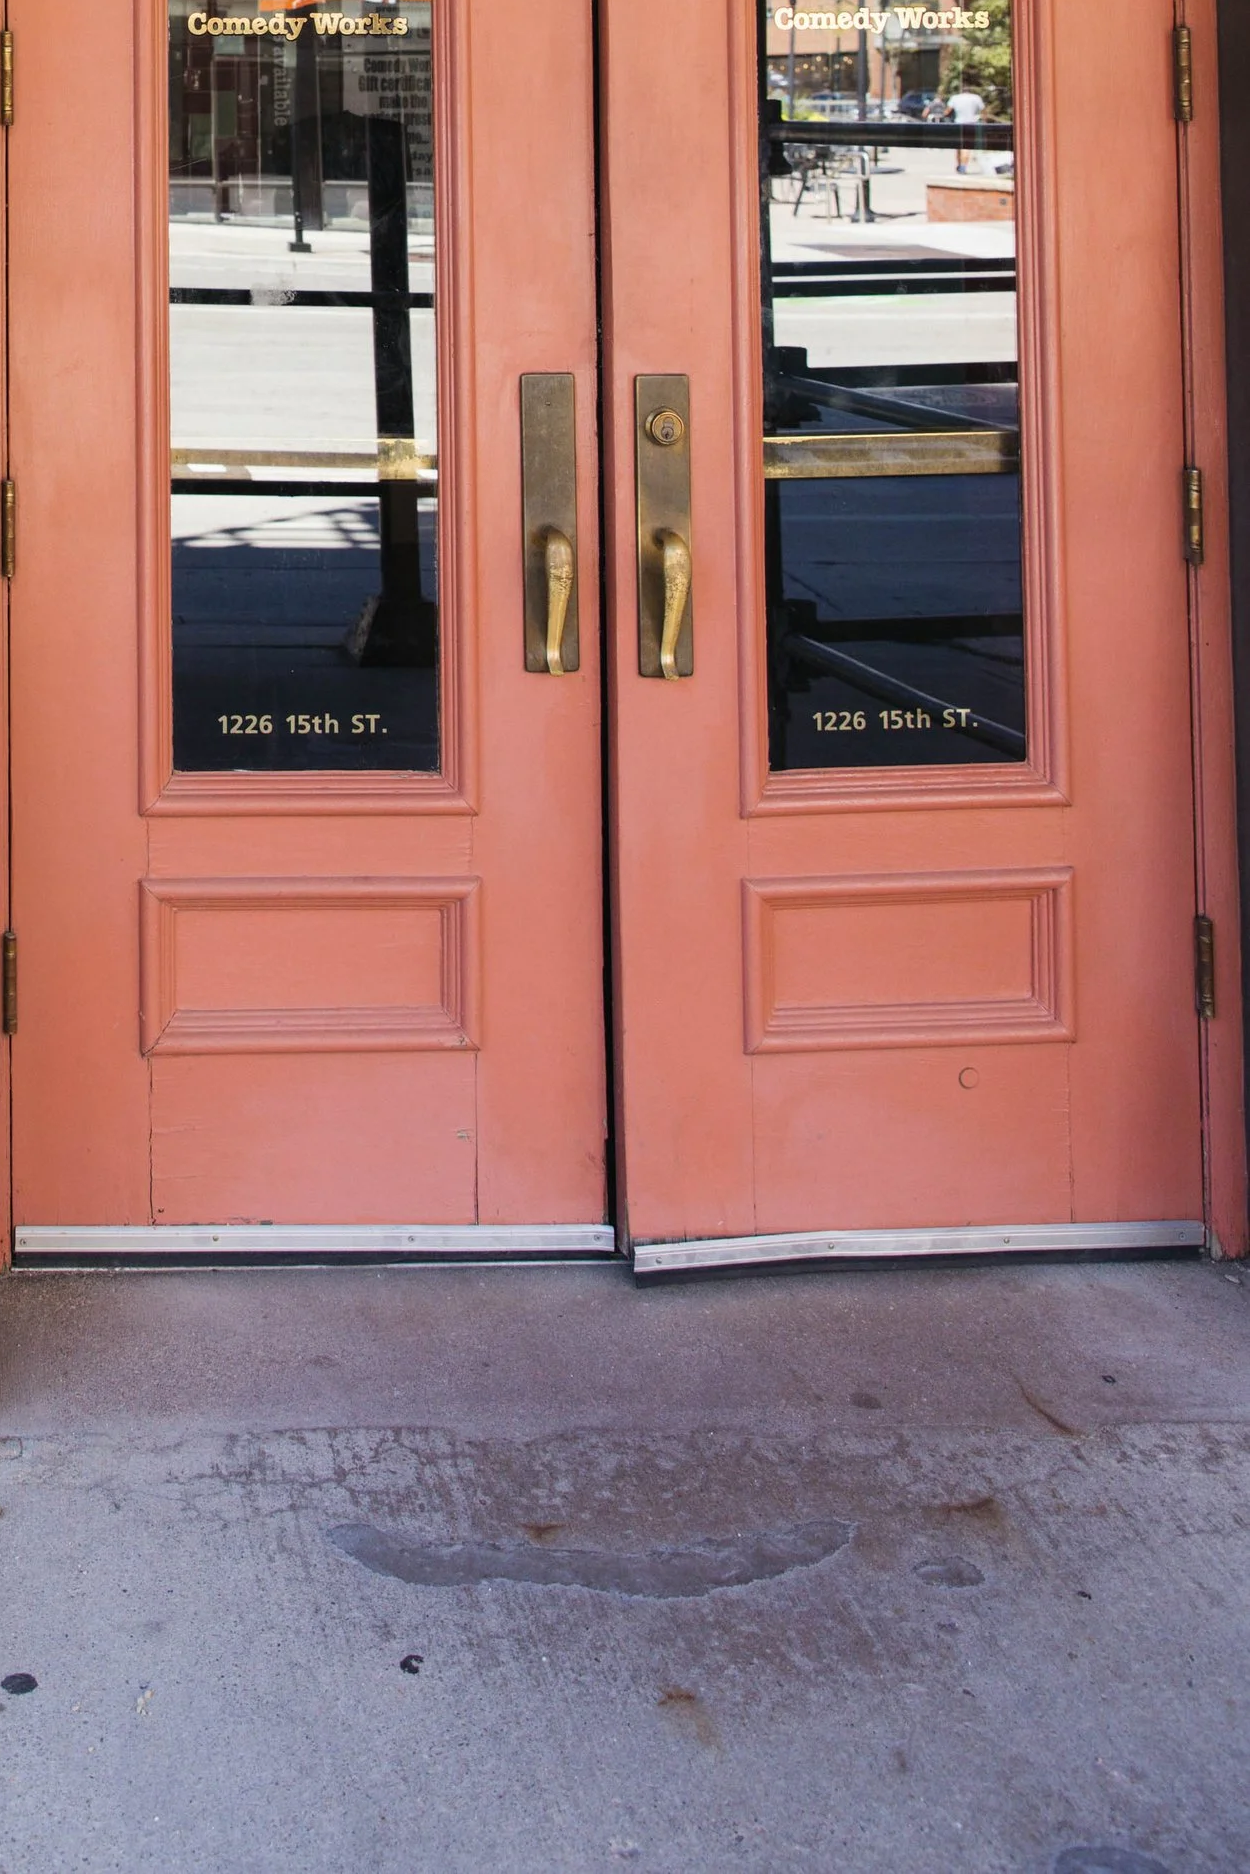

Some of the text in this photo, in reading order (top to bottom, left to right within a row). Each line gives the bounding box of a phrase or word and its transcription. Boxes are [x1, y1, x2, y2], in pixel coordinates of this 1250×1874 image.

[187, 12, 409, 41] Comedy Works
[774, 6, 990, 34] Comedy Works
[217, 712, 388, 735] 1226 15th ST.
[812, 707, 978, 731] 1226 15th ST.
